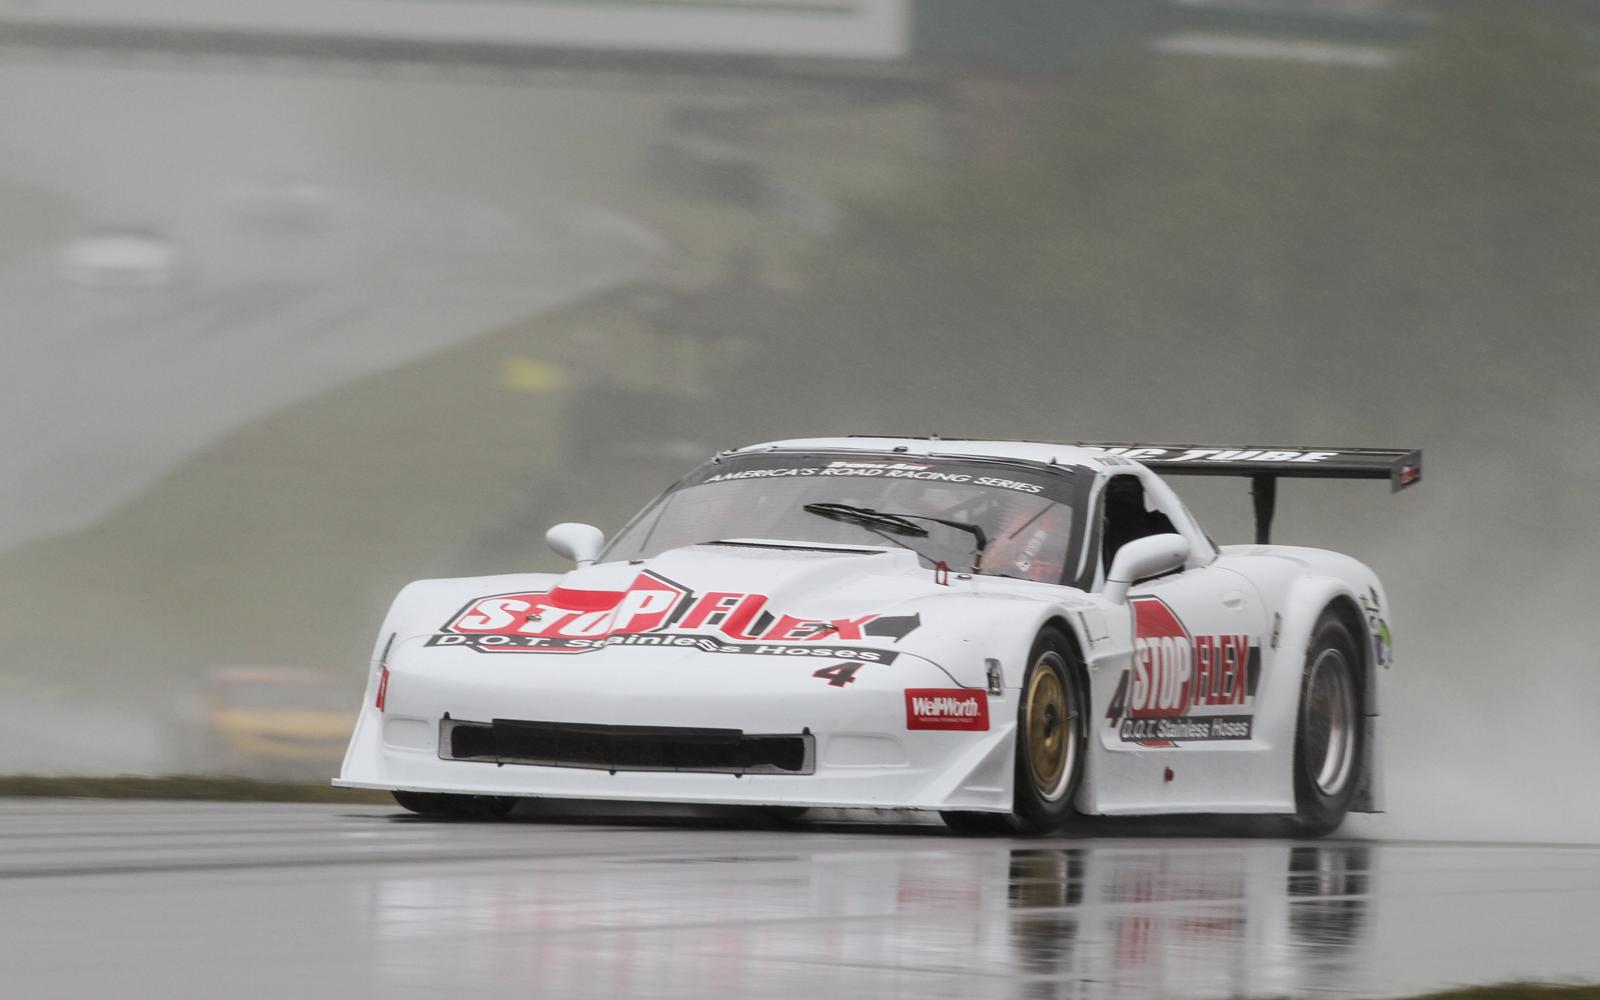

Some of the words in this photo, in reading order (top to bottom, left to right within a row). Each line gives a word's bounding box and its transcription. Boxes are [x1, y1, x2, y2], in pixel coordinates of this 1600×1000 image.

[1174, 449, 1339, 462] TUBE
[703, 468, 819, 483] AMERICA'S
[819, 468, 884, 476] ROAD
[885, 469, 972, 482] RACING
[973, 477, 1044, 493] SERIES
[436, 635, 549, 647] D.O.T.
[754, 645, 881, 661] Hoses
[812, 662, 864, 687] 4
[1132, 636, 1192, 710] STOP
[1193, 634, 1249, 706] FLEX
[1156, 718, 1210, 738] Stainless
[1210, 718, 1248, 737] Hoses
